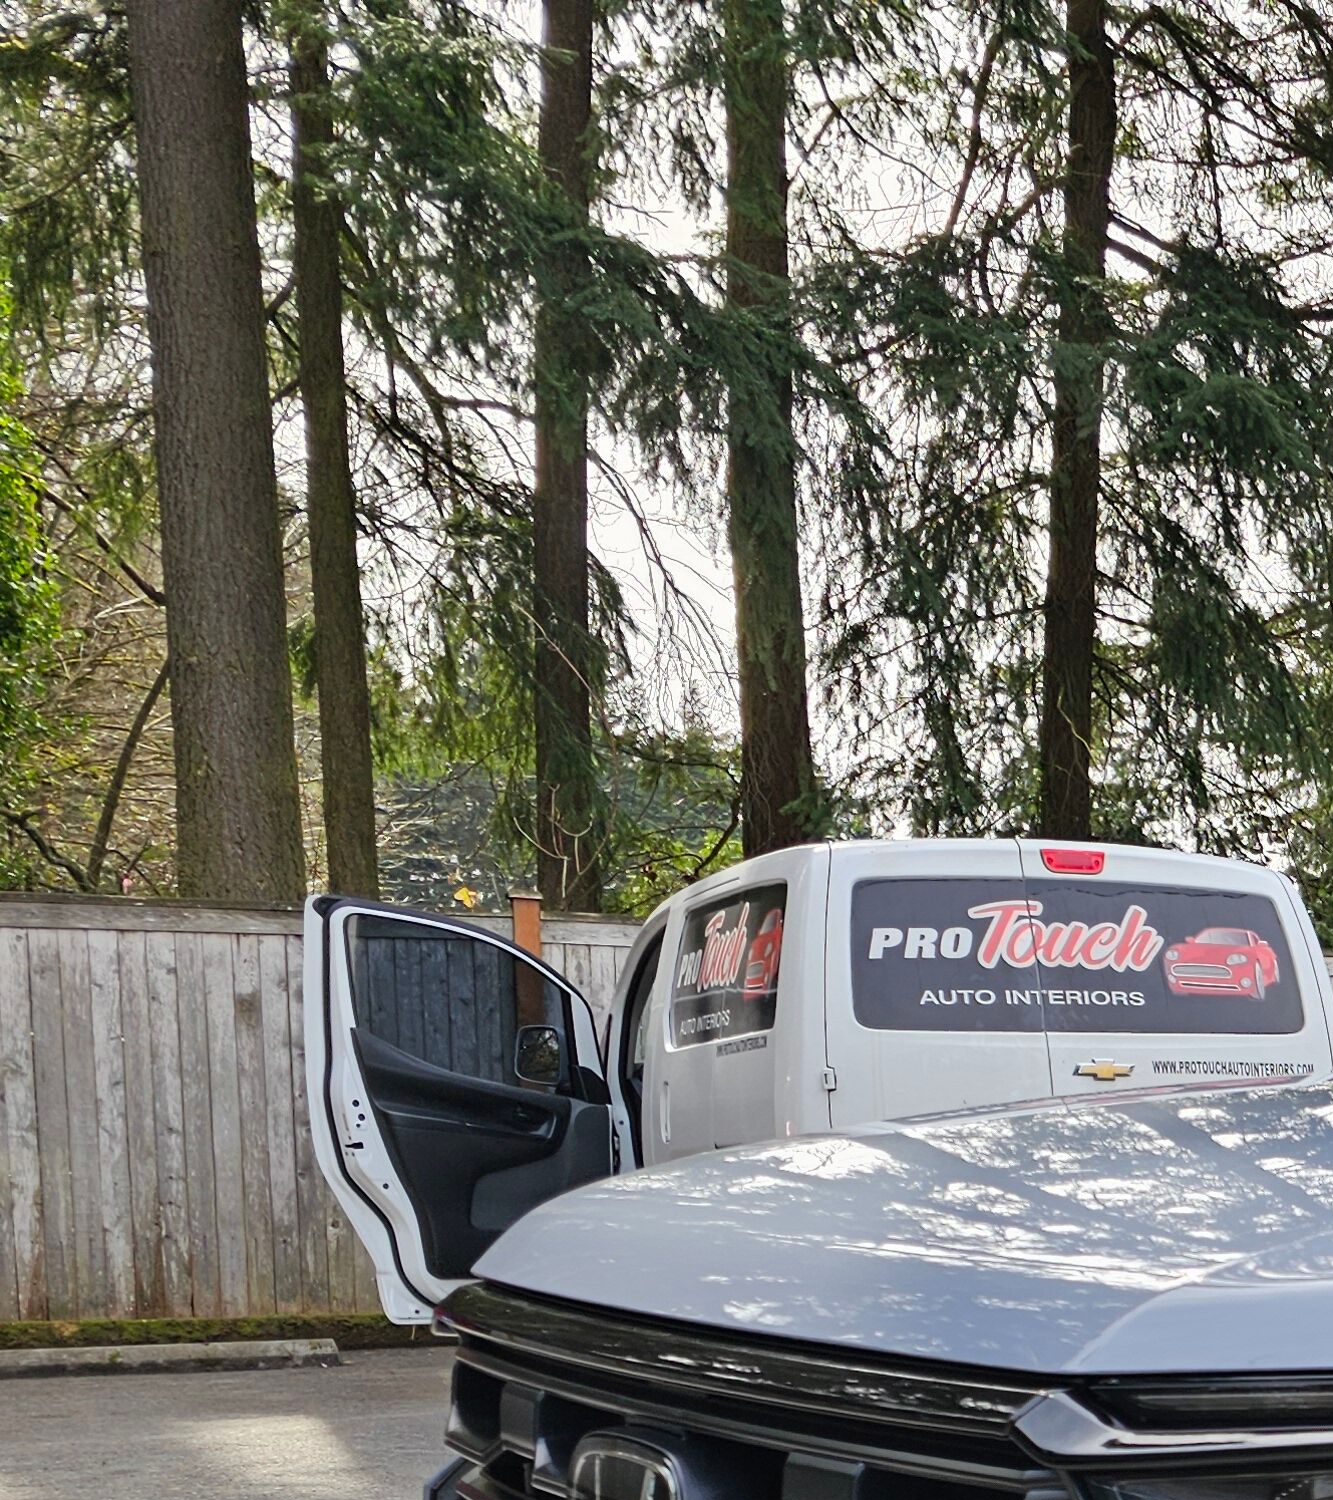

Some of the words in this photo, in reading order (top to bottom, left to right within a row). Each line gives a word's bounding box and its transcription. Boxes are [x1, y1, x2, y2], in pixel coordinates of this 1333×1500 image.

[677, 949, 703, 989] PRO
[696, 901, 750, 993] Touch
[868, 926, 973, 960] PRO
[967, 899, 1165, 973] Touch
[920, 989, 997, 1006] AUTO
[1004, 989, 1146, 1007] INTERIORS
[680, 1013, 697, 1036] AUTO
